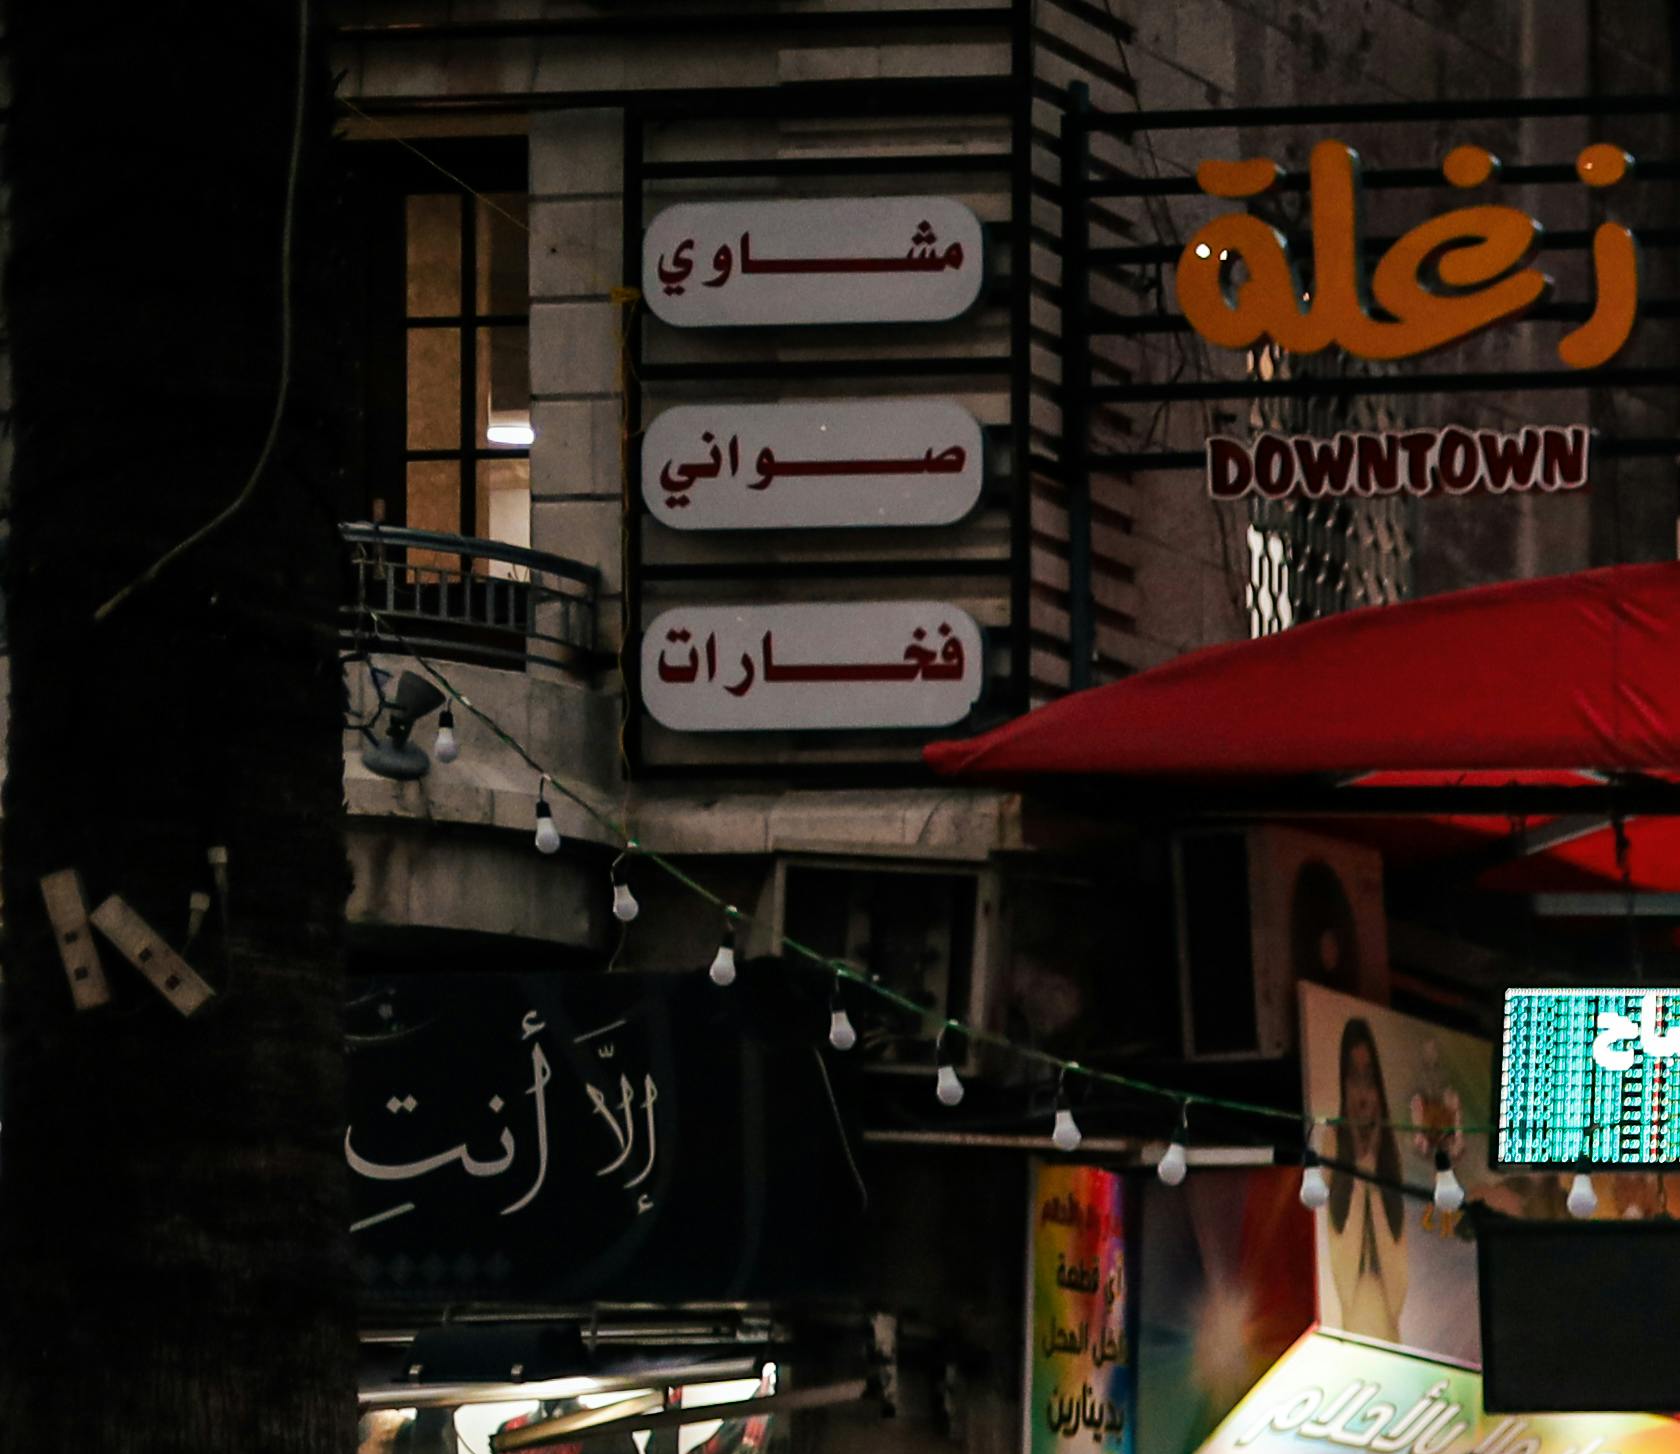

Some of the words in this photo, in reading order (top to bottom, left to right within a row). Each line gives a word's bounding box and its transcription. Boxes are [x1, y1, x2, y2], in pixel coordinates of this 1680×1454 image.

[657, 218, 965, 296] مشاوي
[1174, 138, 1642, 371] زغلة
[657, 431, 968, 513] صواني
[1207, 420, 1593, 504] DOWNTOWN
[656, 622, 966, 698] فخارات
[1046, 1381, 1124, 1443] بدينارين
